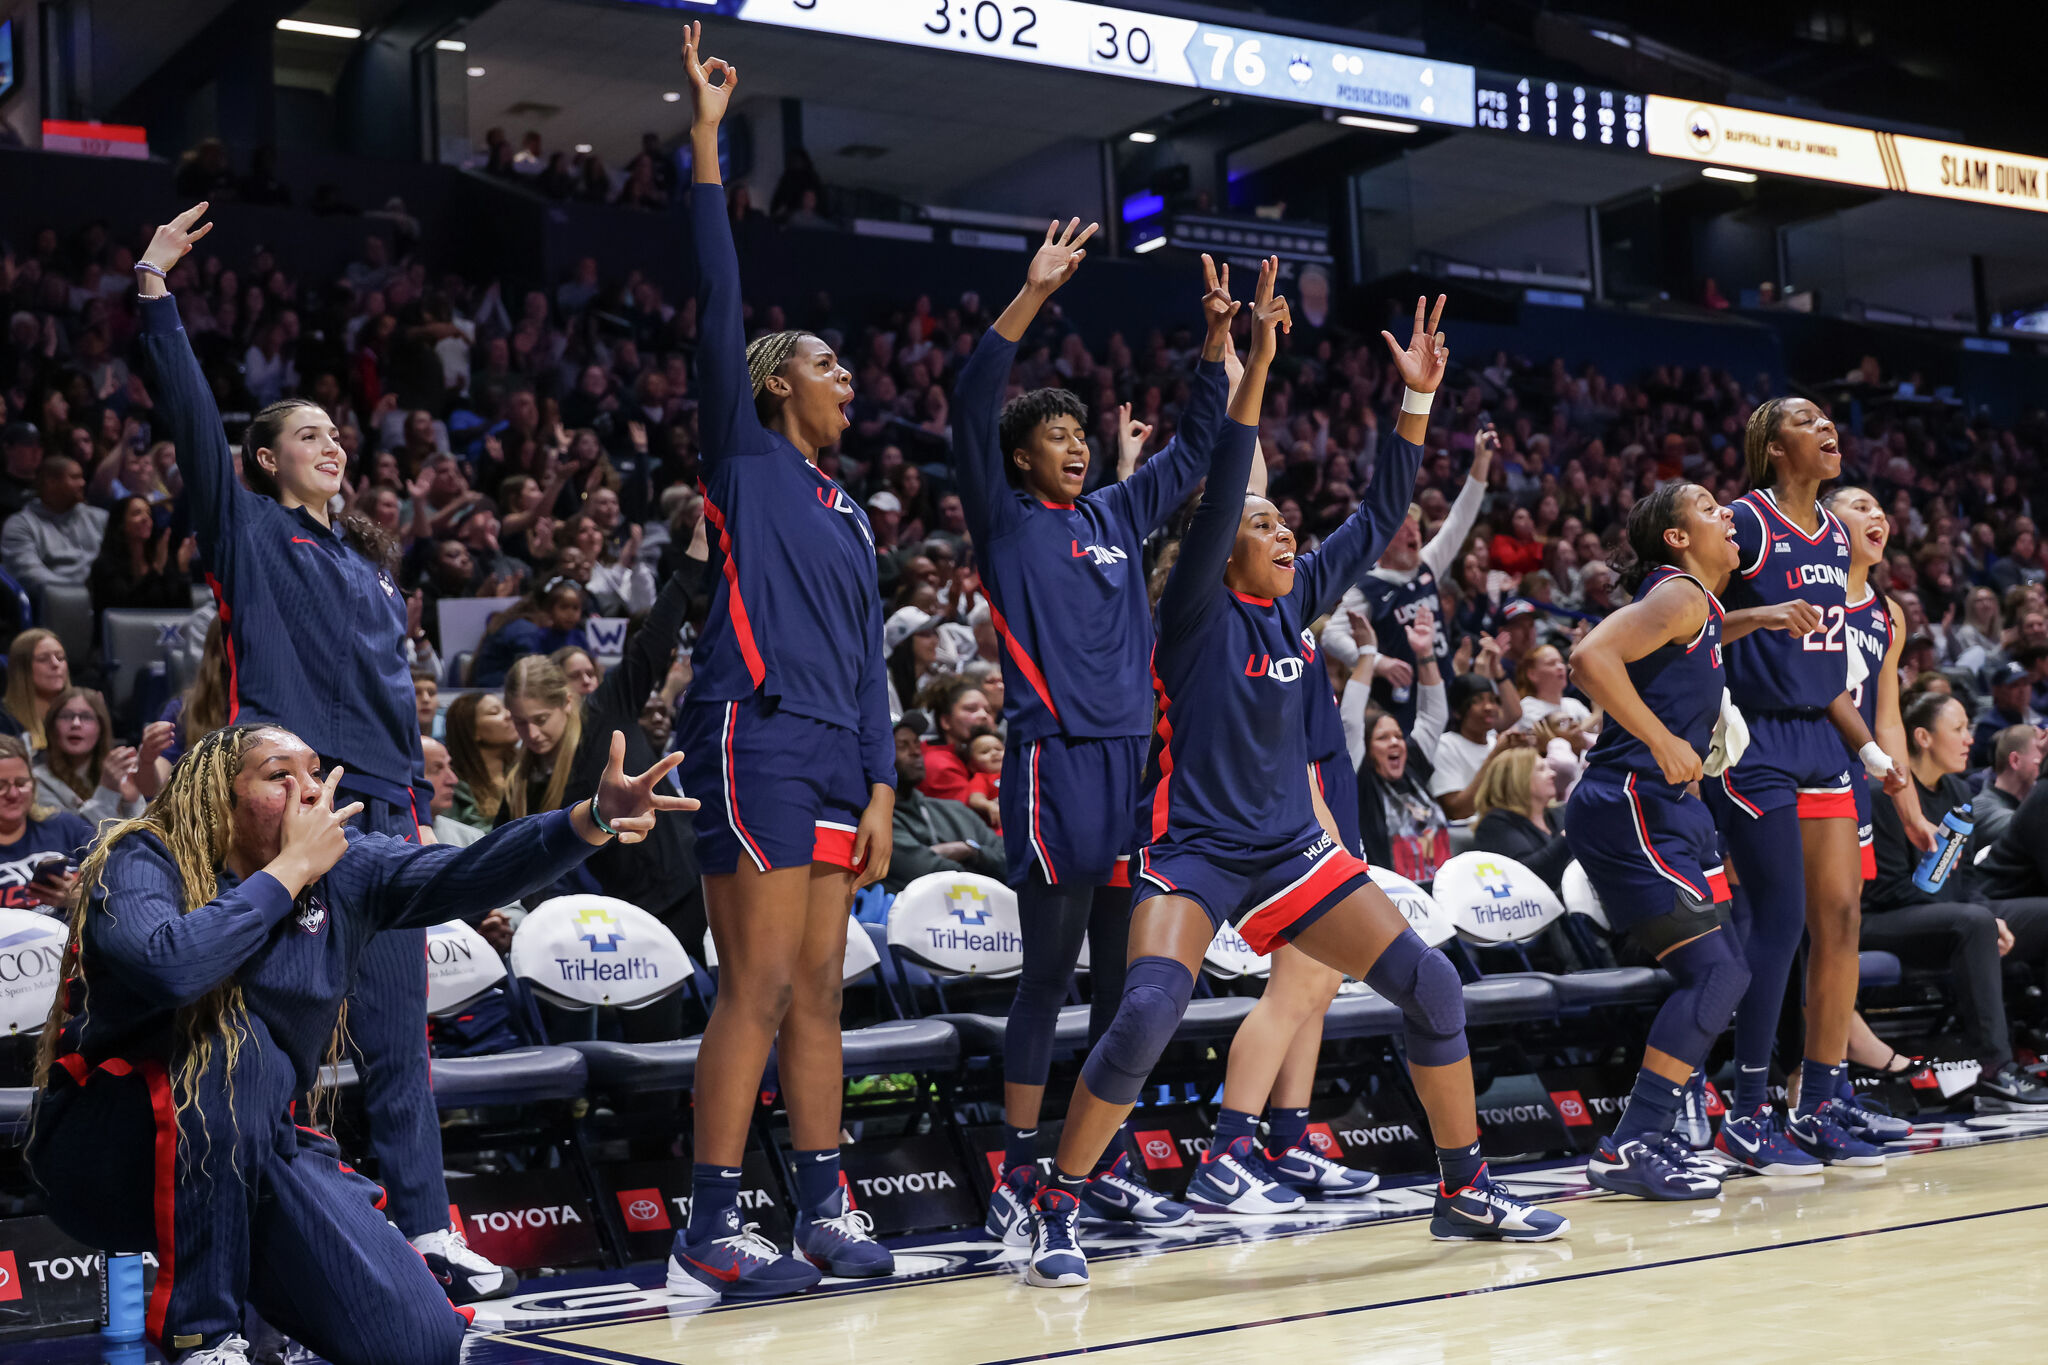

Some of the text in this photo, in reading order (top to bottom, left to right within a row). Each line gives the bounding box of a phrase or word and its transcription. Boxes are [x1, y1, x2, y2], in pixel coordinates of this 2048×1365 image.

[924, 0, 1151, 64] 3:02 30
[1203, 32, 1266, 86] 76
[1940, 155, 2039, 198] SLAM DUNK
[1802, 604, 1846, 652] 22
[1471, 899, 1544, 925] TriHealth
[926, 928, 1022, 953] TriHealth
[555, 957, 659, 981] TriHealth
[1478, 1104, 1552, 1126] TOYOTA
[1339, 1124, 1419, 1147] TOYOTA
[857, 1170, 956, 1197] TOYOTA
[470, 1204, 582, 1233] TOYOTA
